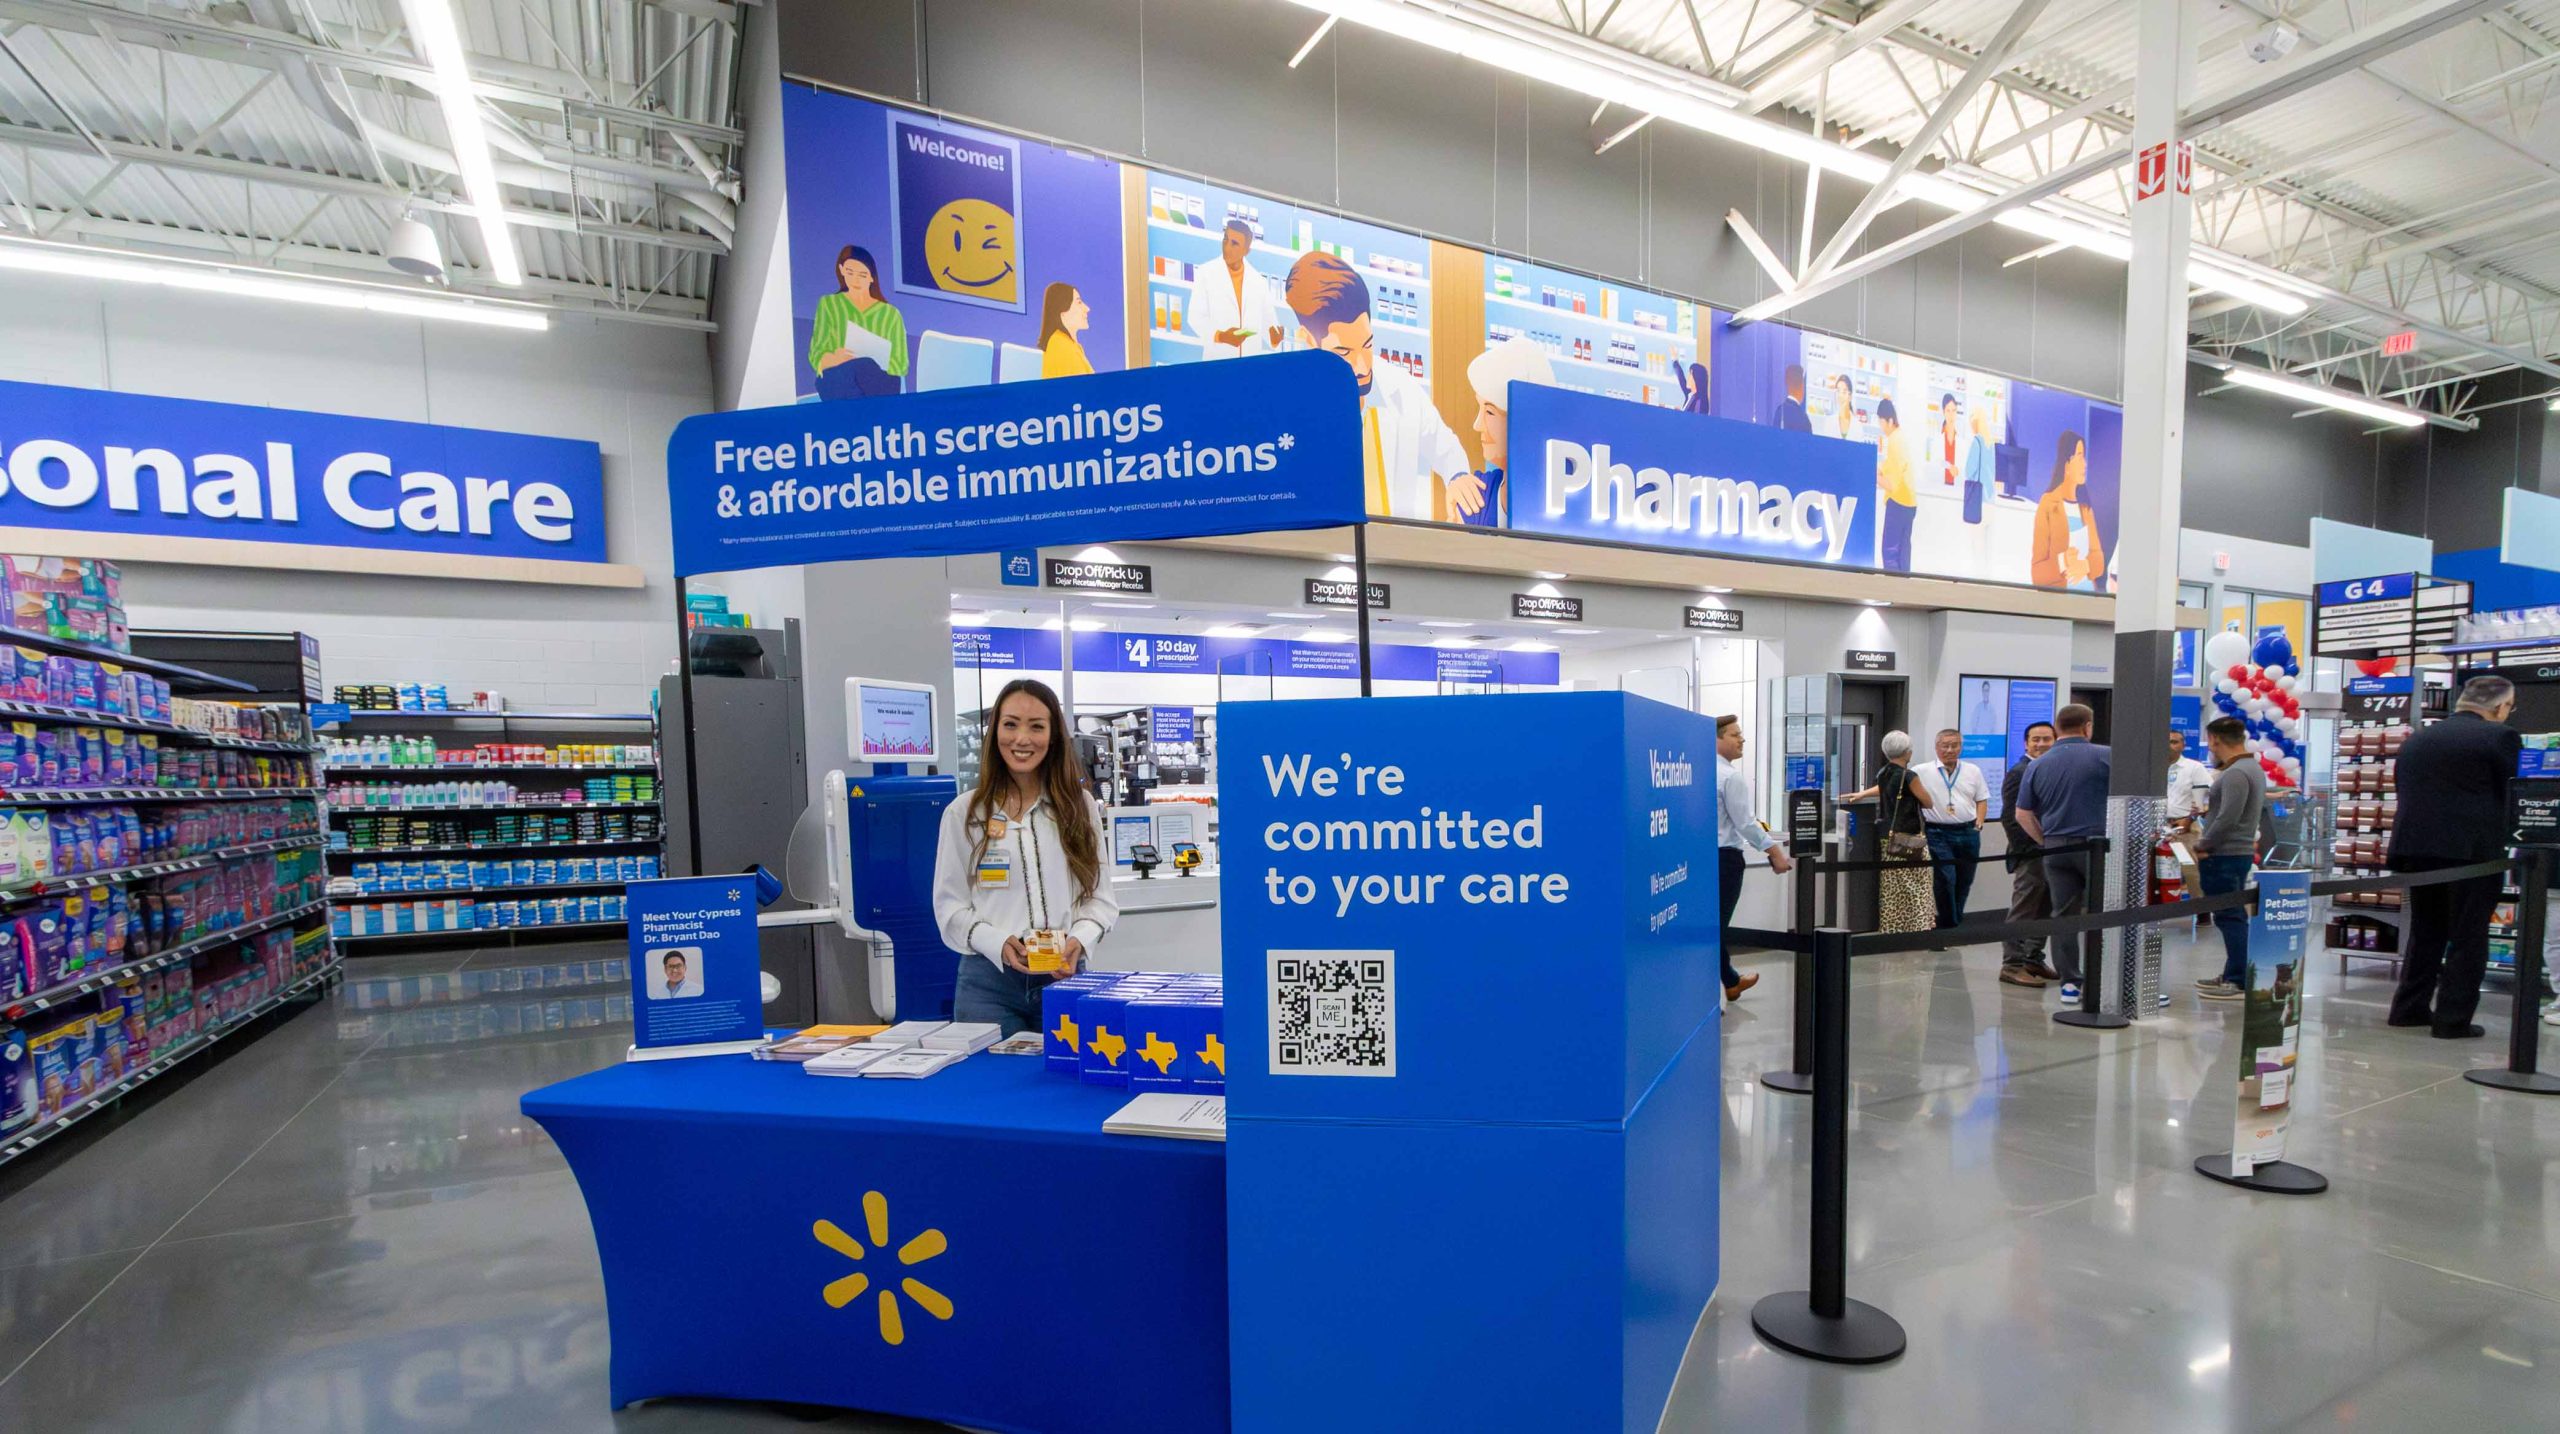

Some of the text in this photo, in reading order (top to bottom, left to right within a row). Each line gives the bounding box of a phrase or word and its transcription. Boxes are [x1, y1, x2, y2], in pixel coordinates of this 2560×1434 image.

[906, 132, 1005, 172] Welcome!
[714, 402, 1163, 474] Free health screenings
[0, 439, 575, 542] onal Care
[716, 484, 742, 518] &
[749, 468, 948, 516] affordable
[1545, 438, 1858, 561] Pharmacy
[954, 518, 980, 528] Subject
[1076, 507, 1094, 516] state
[1108, 505, 1123, 515] Age
[1124, 501, 1160, 512] restriction
[1184, 498, 1198, 506] Ask
[1198, 498, 1215, 508] your
[1215, 494, 1257, 506] pharmacist
[1258, 493, 1268, 501] for
[1055, 563, 1144, 583] Drop Off/Pick Up
[1055, 577, 1072, 586] Dejar
[1121, 581, 1144, 590] Recetas
[1312, 583, 1335, 595] Drop
[1371, 587, 1384, 599] Up
[2345, 580, 2385, 599] G 4
[1312, 595, 1326, 603] Dejar
[1519, 597, 1578, 613] Drop Off/Pick Up
[1690, 609, 1705, 621] Drop
[1730, 612, 1739, 623] Up
[1125, 638, 1150, 668] $4
[1156, 640, 1197, 655] 30 day
[1437, 651, 1450, 659] Save
[1856, 652, 1887, 663] Consultation
[1262, 752, 1405, 798] We’re
[1649, 749, 1692, 788] Vaccination
[2525, 807, 2551, 816] Enter
[1264, 804, 1543, 851] committed
[1650, 808, 1668, 838] area
[1664, 861, 1687, 889] committed
[1264, 867, 1569, 917] to your care
[2265, 899, 2281, 908] Pet
[642, 907, 741, 922] Meet Your Cypress
[1650, 902, 1678, 934] to your care
[643, 920, 704, 933] Pharmacist
[644, 930, 720, 944] Dr. Bryant Dao
[1322, 1011, 1341, 1021] ME
